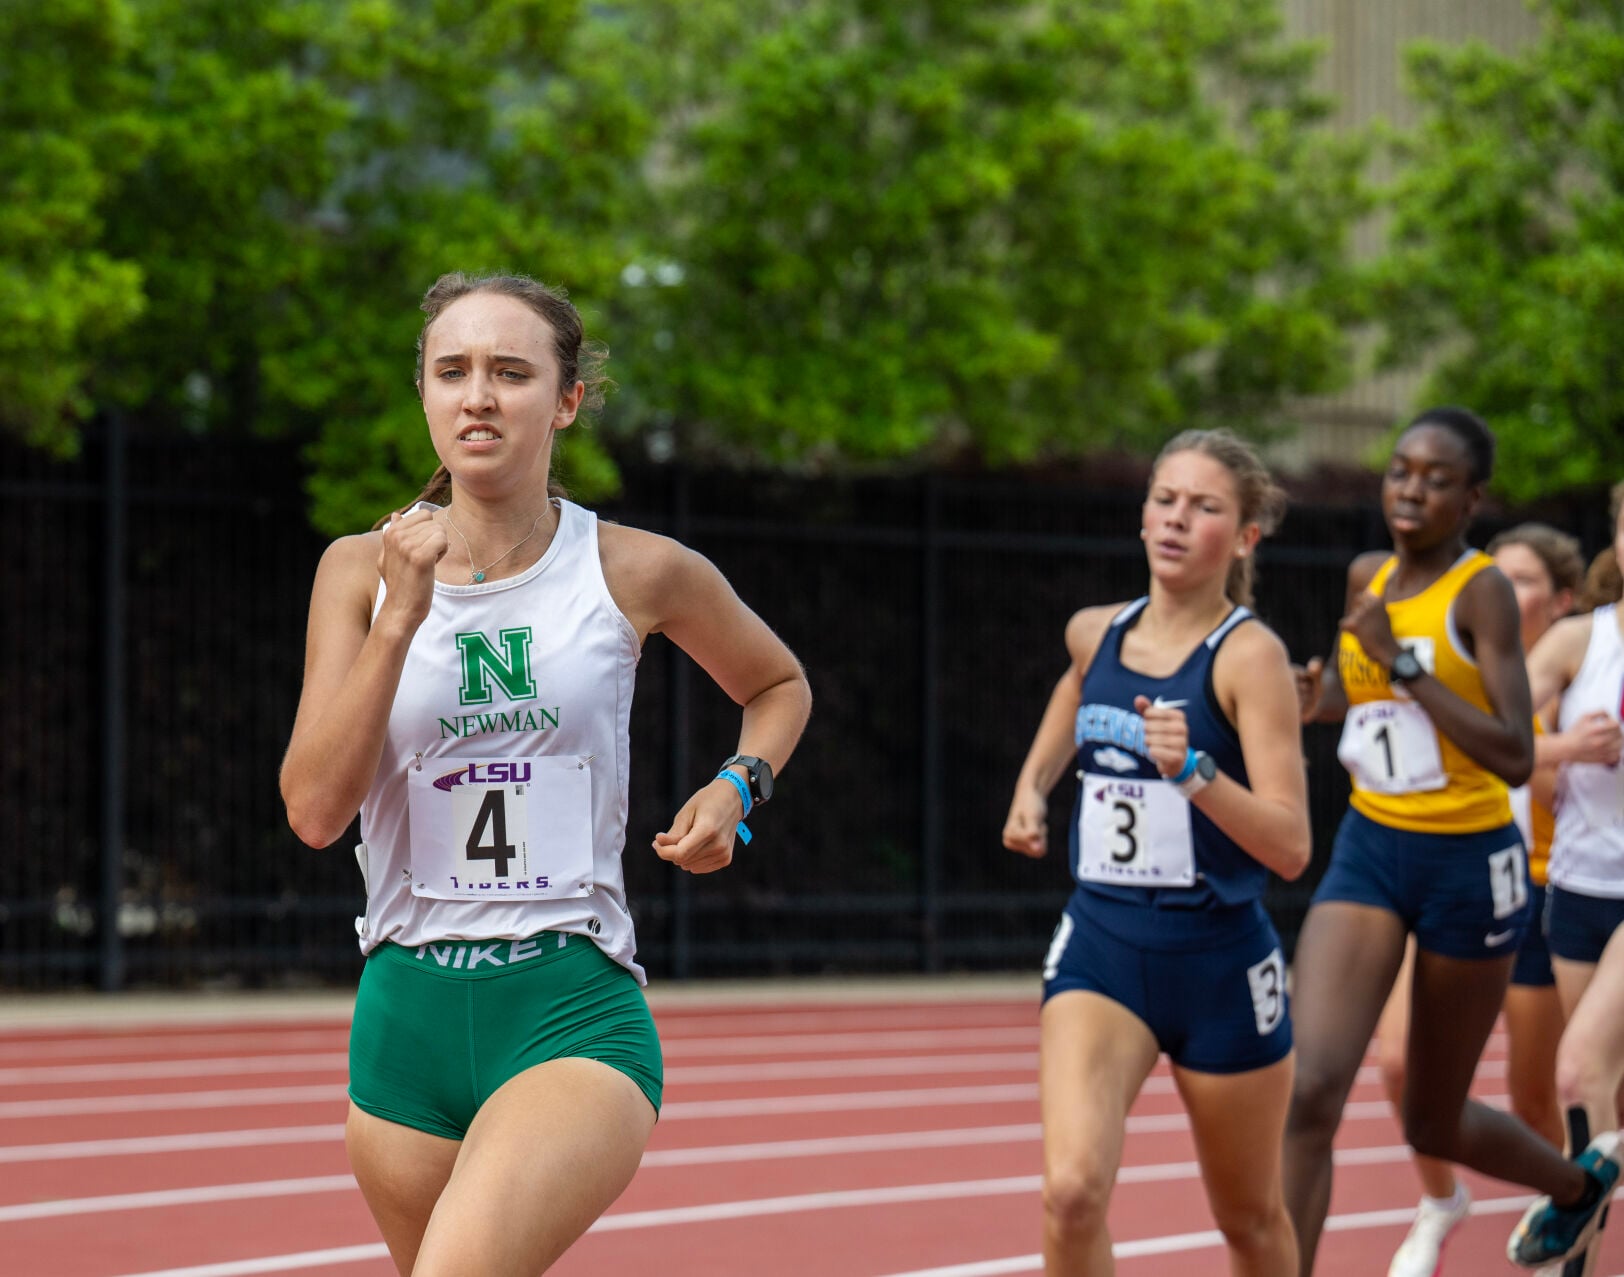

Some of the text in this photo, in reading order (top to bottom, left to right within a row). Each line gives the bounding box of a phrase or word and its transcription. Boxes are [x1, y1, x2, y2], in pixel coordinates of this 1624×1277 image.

[455, 626, 537, 705] N
[437, 707, 560, 739] NEWMAN
[468, 762, 531, 784] LSU
[1374, 725, 1394, 778] 1
[465, 789, 516, 878] 4
[1111, 801, 1137, 864] 3
[1503, 855, 1517, 904] 1
[415, 934, 544, 969] NIKE
[1260, 962, 1279, 1025] 3
